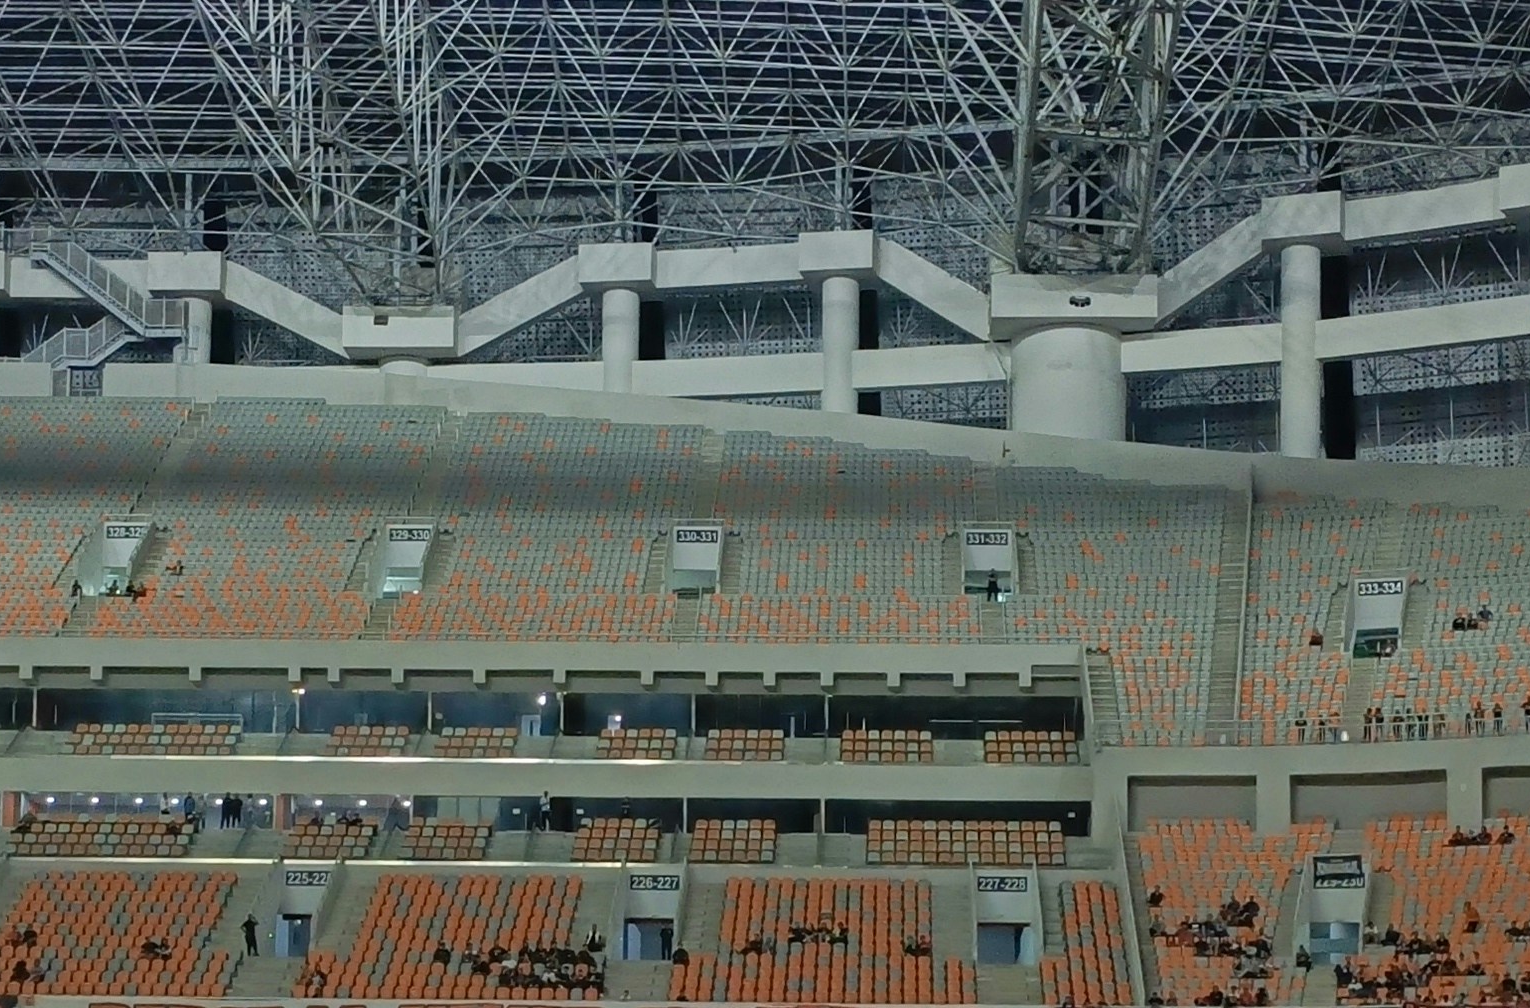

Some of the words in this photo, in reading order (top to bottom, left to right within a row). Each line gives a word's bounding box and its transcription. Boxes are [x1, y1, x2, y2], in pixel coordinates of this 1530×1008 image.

[390, 528, 430, 541] 329-330
[677, 529, 718, 542] 330-331
[967, 532, 1008, 545] 331-332
[1358, 580, 1403, 595] 333-334
[631, 876, 679, 889] 226-227
[979, 878, 1027, 891] 227-228
